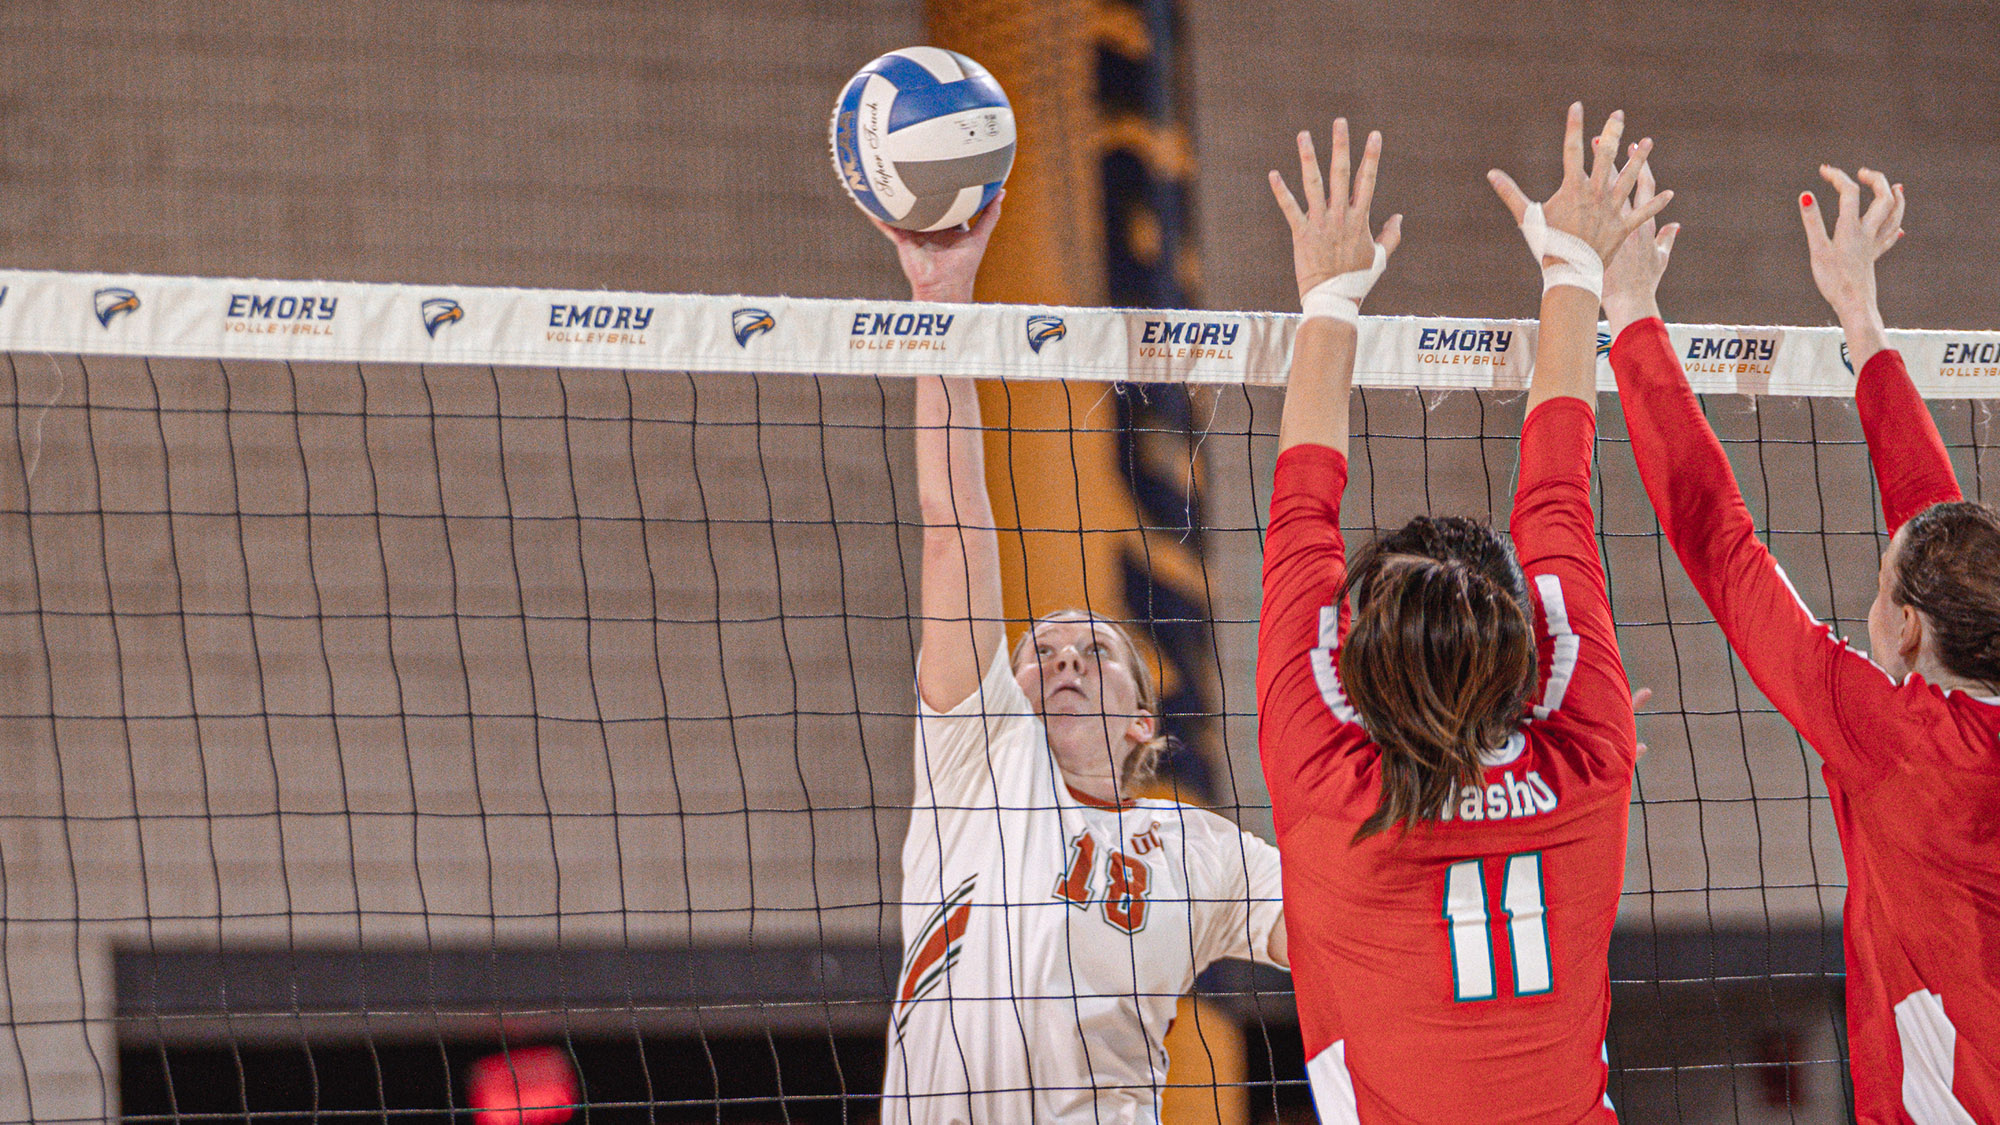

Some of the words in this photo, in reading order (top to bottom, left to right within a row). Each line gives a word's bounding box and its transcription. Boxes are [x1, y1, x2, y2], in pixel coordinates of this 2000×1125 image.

[863, 102, 880, 150] Touch
[873, 154, 894, 198] Super
[227, 294, 339, 320] EMORY
[549, 304, 655, 330] EMORY
[224, 322, 334, 335] VOLLEYBALL
[851, 313, 955, 336] EMORY
[1141, 321, 1240, 345] EMORY
[546, 331, 646, 345] VOLLEYBALL
[849, 339, 947, 351] VOLLEYBALL
[1418, 328, 1513, 352] EMORY
[1687, 337, 1775, 361] EMORY
[1139, 347, 1234, 360] VOLLEYBALL
[1417, 353, 1507, 366] VOLLEYBALL
[1684, 362, 1772, 375] VOLLEYBALL
[1940, 367, 2000, 377] VOLLEYB
[1051, 827, 1153, 936] 18
[1441, 851, 1554, 1003] 11
